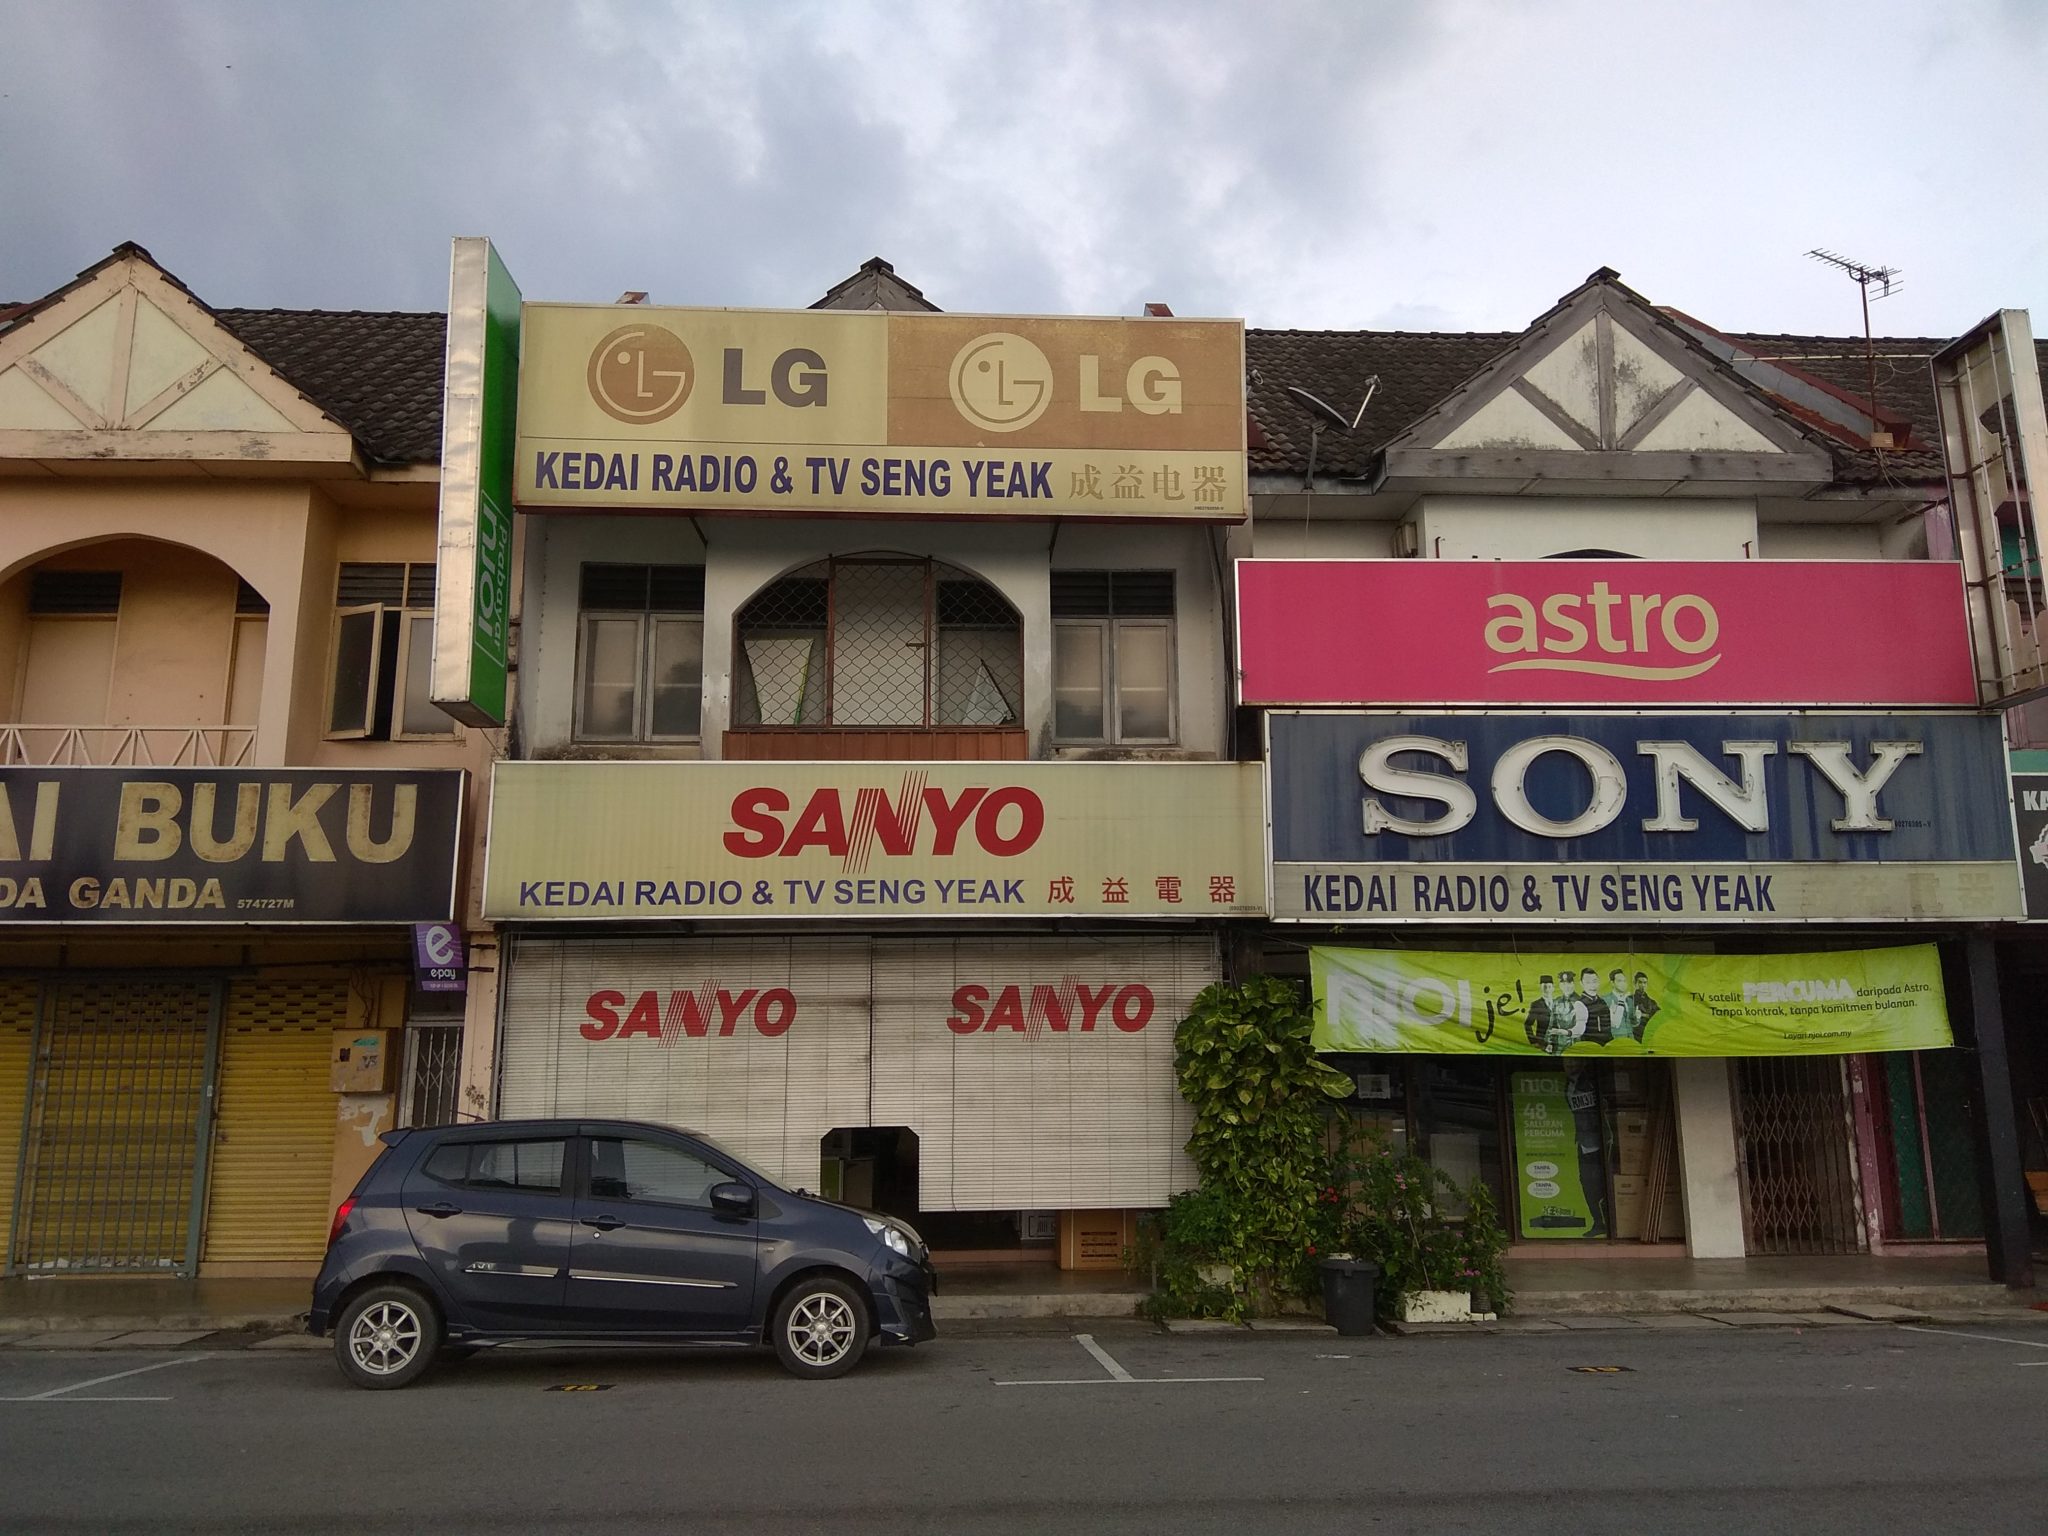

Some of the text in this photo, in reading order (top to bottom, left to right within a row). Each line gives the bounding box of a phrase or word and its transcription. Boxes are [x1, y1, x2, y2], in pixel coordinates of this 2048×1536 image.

[722, 348, 828, 408] LG
[1080, 355, 1183, 415] LG
[535, 452, 1054, 498] KEDAI RADIO & TV SENG YEAK
[1069, 464, 1228, 502] 成益电器
[1485, 582, 1721, 655] astro
[1359, 735, 1925, 838] SONY
[114, 782, 418, 863] BUKU
[723, 771, 1045, 874] SANYO
[68, 877, 226, 909] GANDA
[237, 899, 295, 909] 574727M
[520, 879, 1025, 907] KEDAI RADIO & TV SENG YEAK
[1047, 875, 1236, 904] 成益電器
[1304, 875, 1398, 912] KEDAI
[1413, 875, 1510, 912] RADIO
[1521, 877, 1542, 912] &
[1552, 876, 1591, 911] TV
[1601, 875, 1683, 912] SENG
[1692, 875, 1776, 912] YEAK
[947, 974, 1155, 1043] SANYO
[1690, 978, 1932, 1004] TV satelit PERCUMA daripada Astro.
[1711, 998, 1918, 1018] Tanpa kontrak, tanpa komitmen bulanan.
[579, 979, 797, 1049] SANYO
[1475, 979, 1527, 1043] je!
[1523, 1102, 1547, 1120] 48
[1524, 1120, 1563, 1129] SALURAN
[1524, 1128, 1565, 1137] PERCUMA
